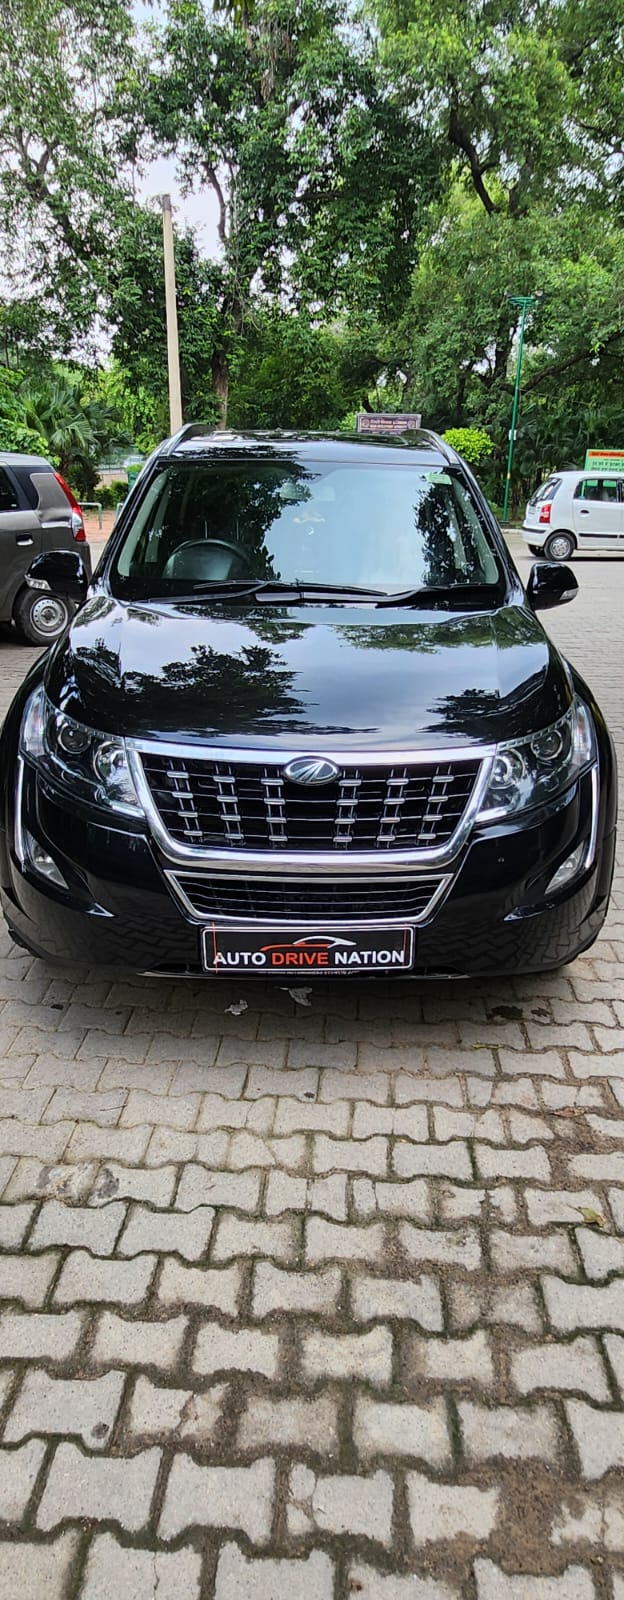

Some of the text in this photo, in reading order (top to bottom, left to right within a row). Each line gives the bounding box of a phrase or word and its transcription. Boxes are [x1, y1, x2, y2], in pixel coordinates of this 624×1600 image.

[214, 950, 405, 966] AUTO DRIVE NATION
